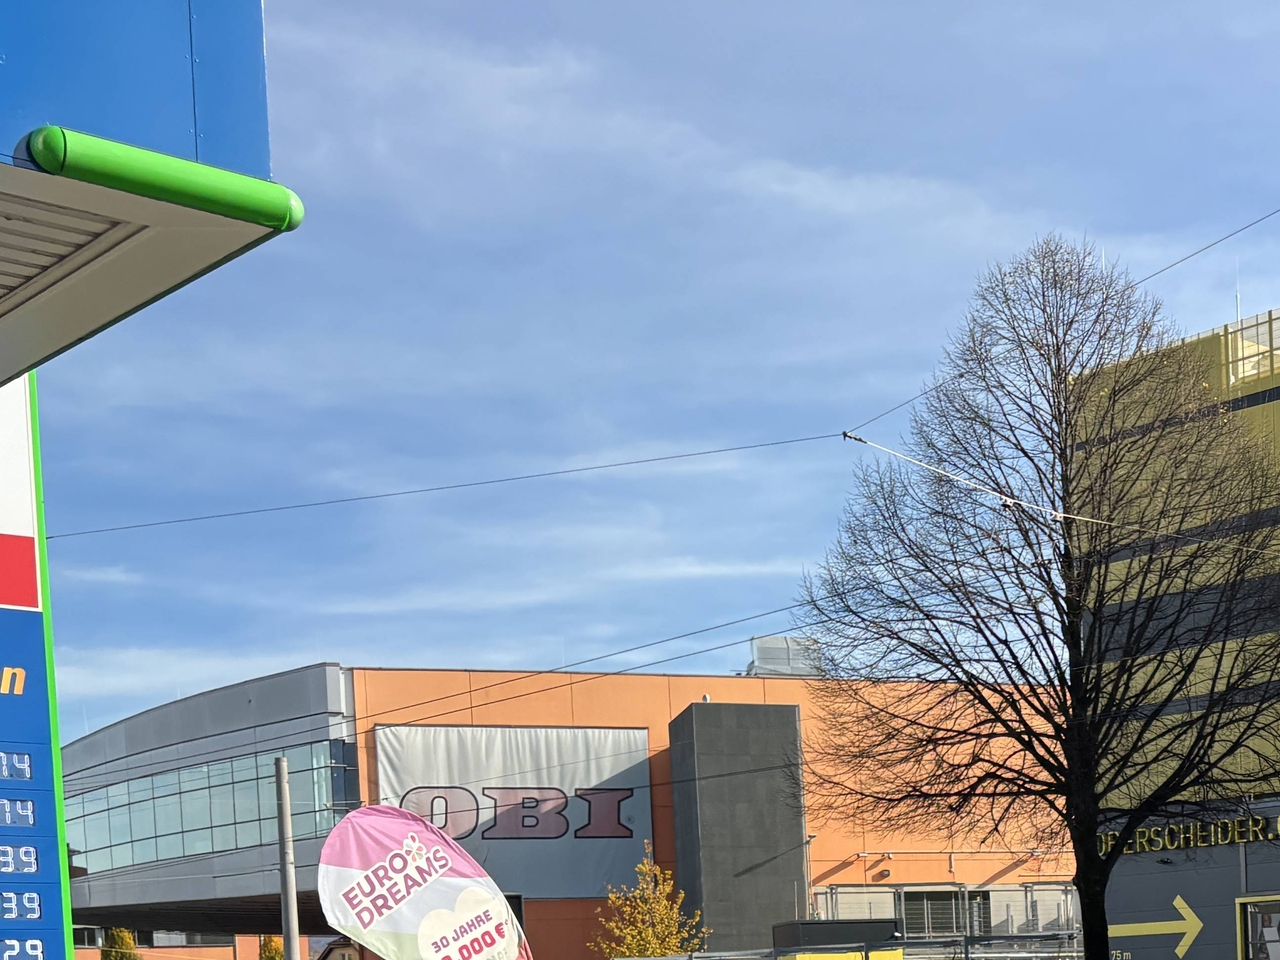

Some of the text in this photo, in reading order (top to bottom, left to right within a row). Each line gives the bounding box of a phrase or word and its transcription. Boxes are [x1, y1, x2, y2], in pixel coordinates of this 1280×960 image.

[400, 786, 634, 840] OBI
[2, 892, 41, 919] 39
[342, 852, 409, 911] EURO
[355, 848, 450, 930] DREAMS
[431, 909, 493, 954] 30 JAHRE
[1110, 950, 1132, 960] 75 m
